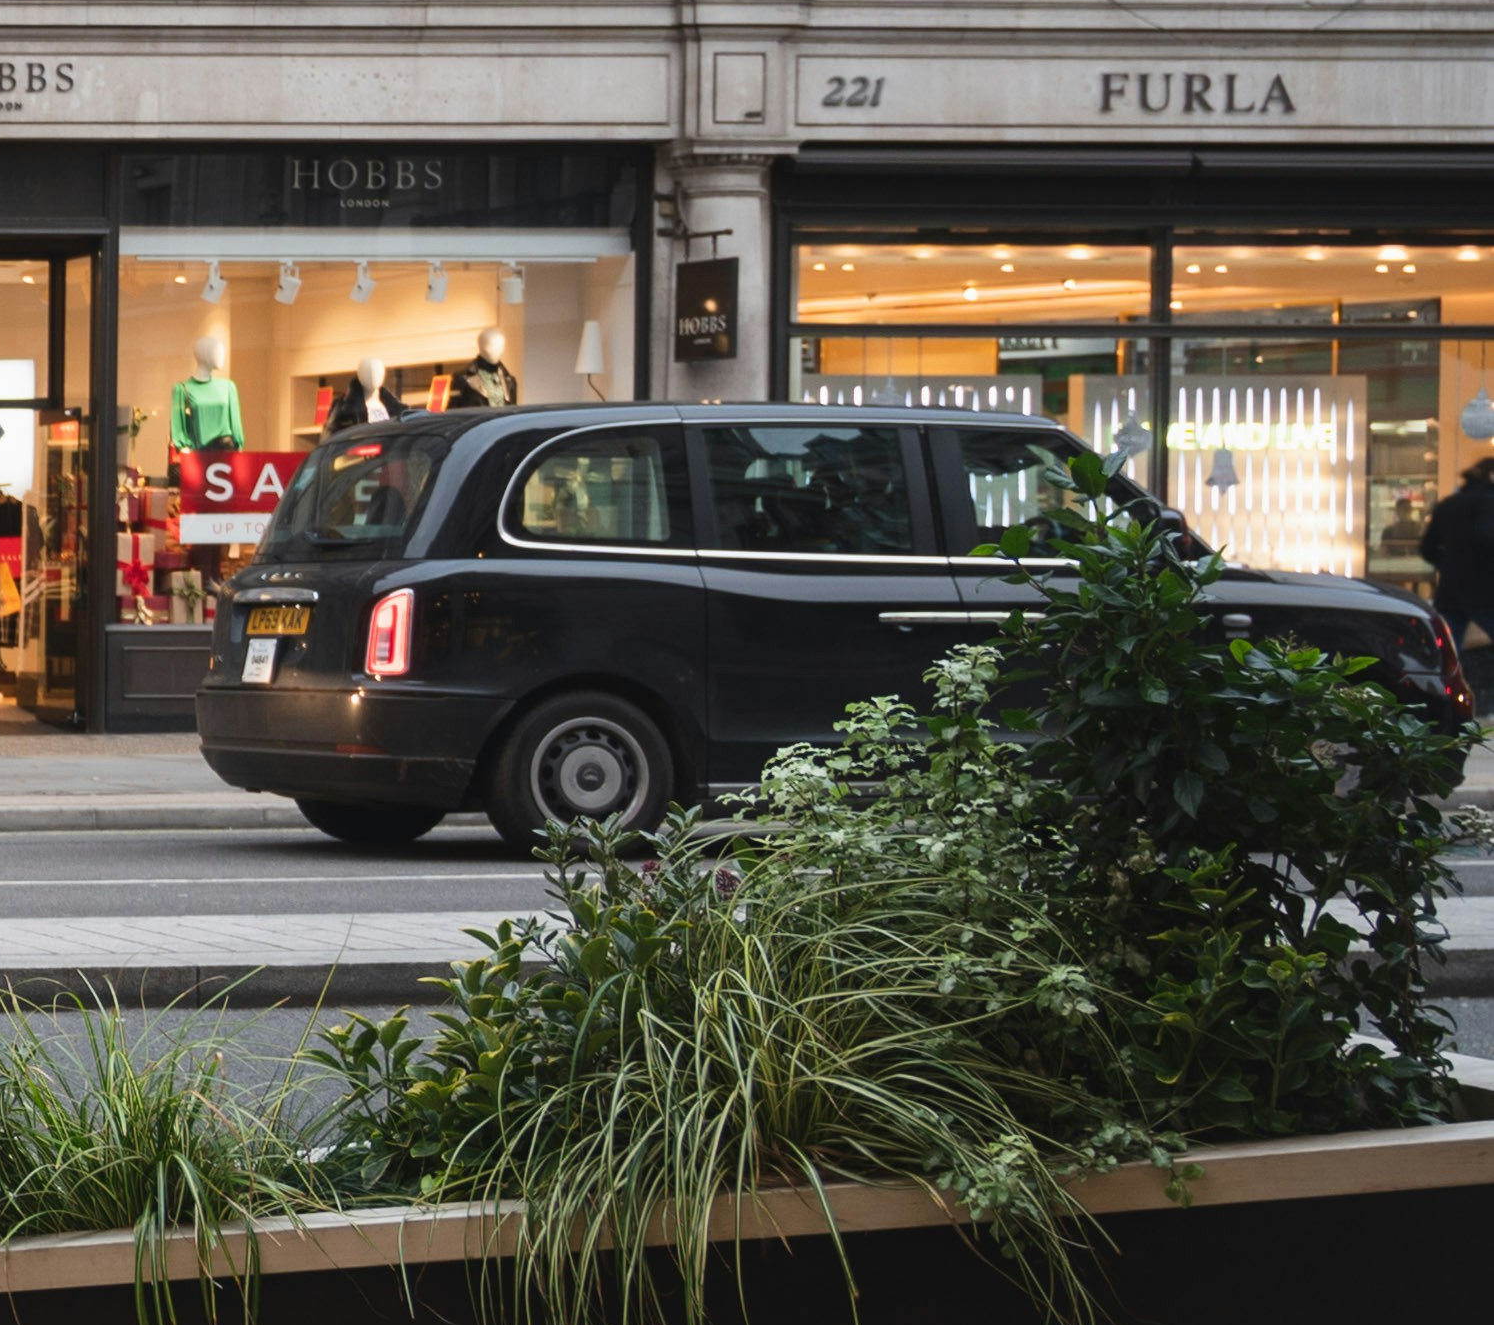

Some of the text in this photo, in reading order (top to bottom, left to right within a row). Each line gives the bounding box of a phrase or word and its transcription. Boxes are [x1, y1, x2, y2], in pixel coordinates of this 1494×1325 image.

[821, 75, 885, 108] 221
[1098, 72, 1297, 115] FURLA
[291, 158, 444, 191] HOBBS
[340, 198, 391, 208] LONDON
[679, 314, 728, 336] HOBBS
[212, 522, 268, 535] UP TO
